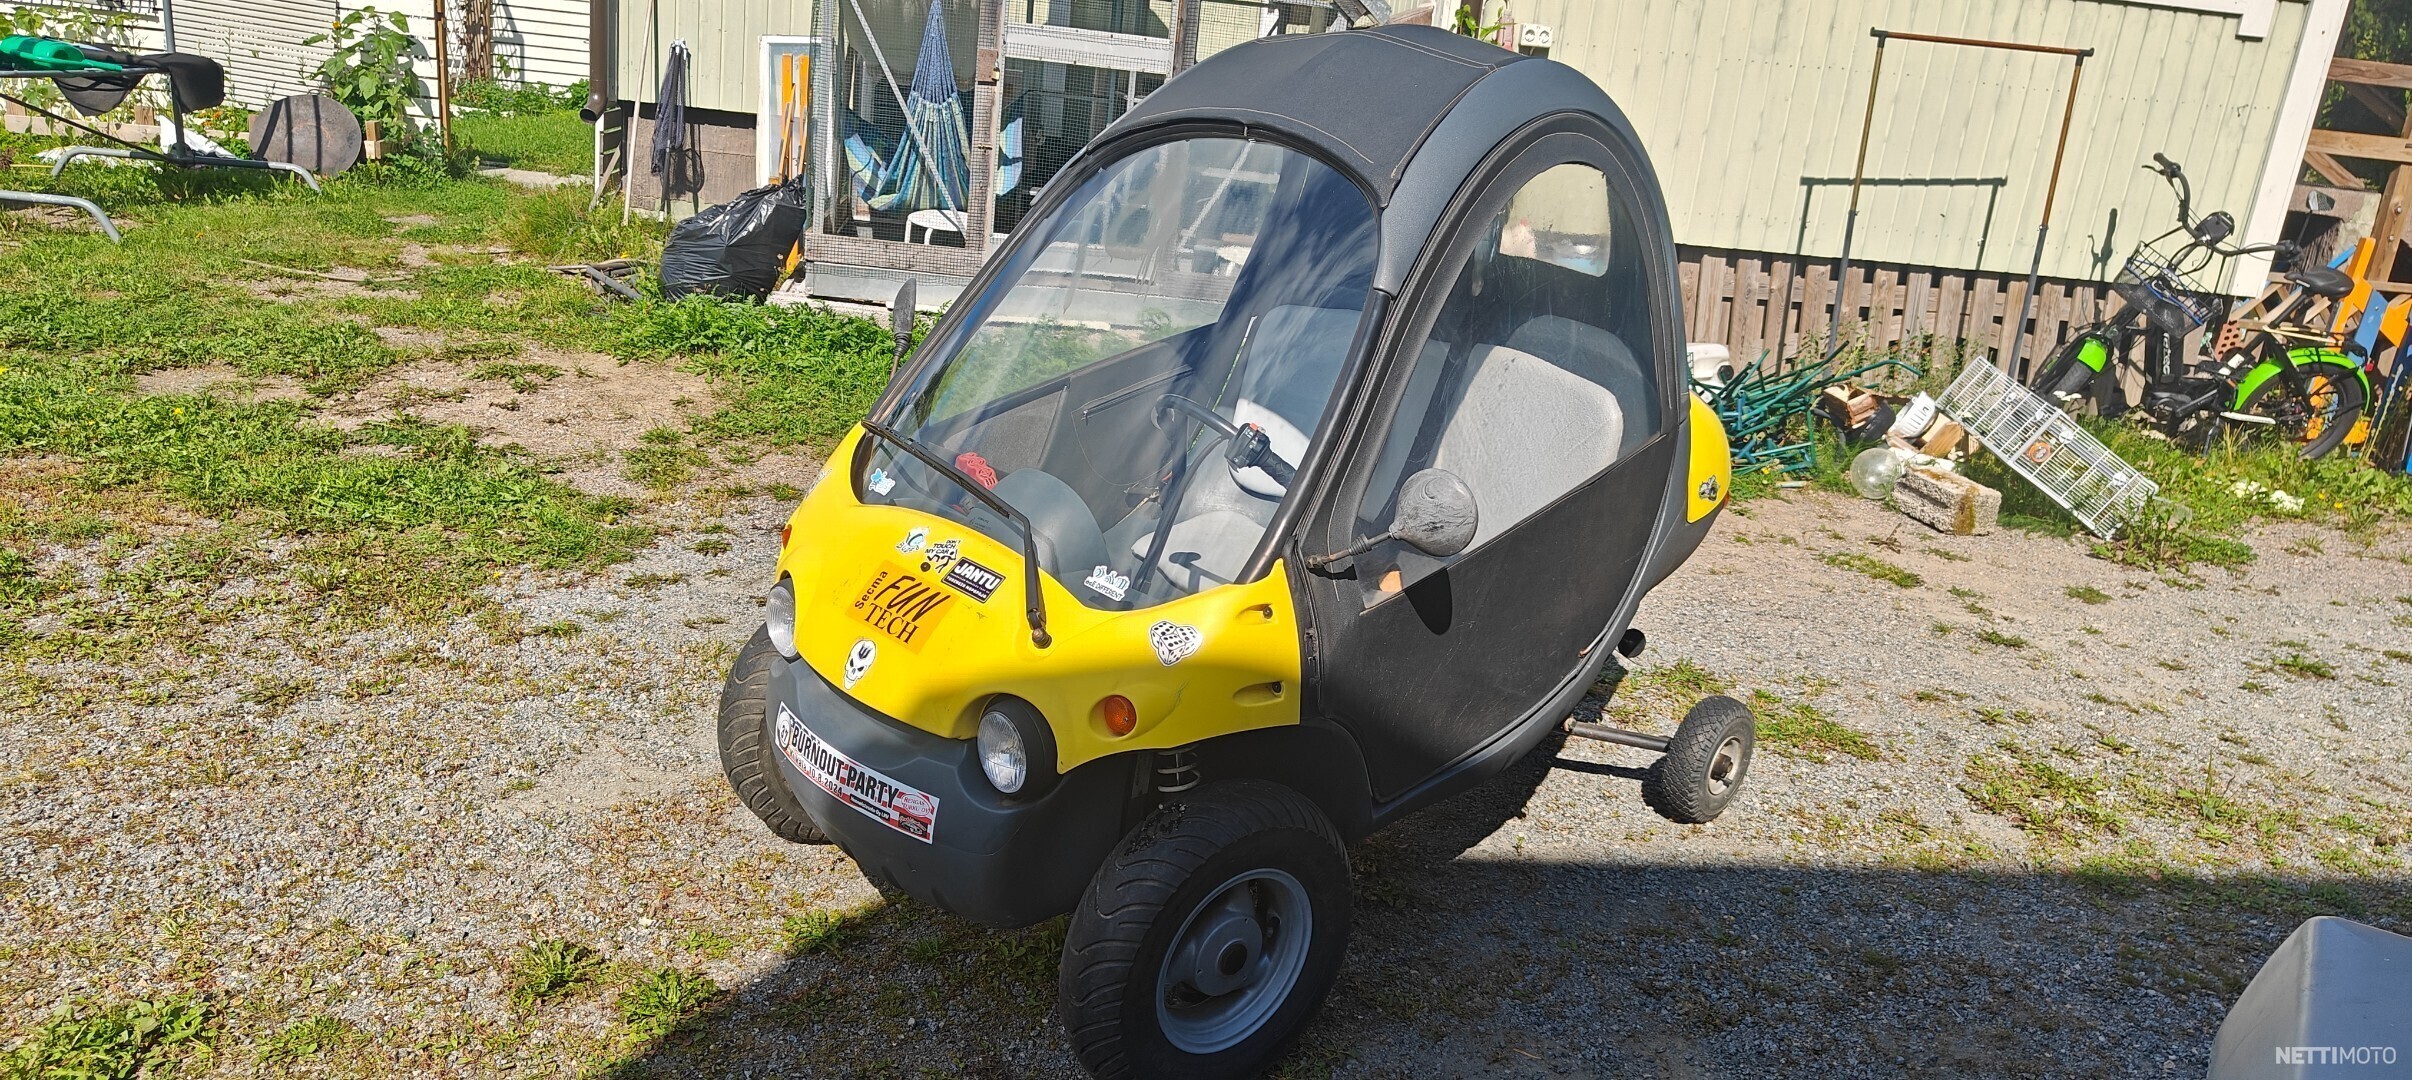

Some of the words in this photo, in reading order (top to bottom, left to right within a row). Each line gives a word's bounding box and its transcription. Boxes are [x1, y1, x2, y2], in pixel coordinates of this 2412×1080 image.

[854, 571, 888, 609] Secma
[954, 562, 1001, 590] JANTU
[1095, 583, 1123, 600] DIFFERENT
[873, 575, 951, 622] FUN
[864, 602, 919, 644] TECH
[792, 725, 844, 781] BURNOUT
[846, 765, 899, 809] PARTY
